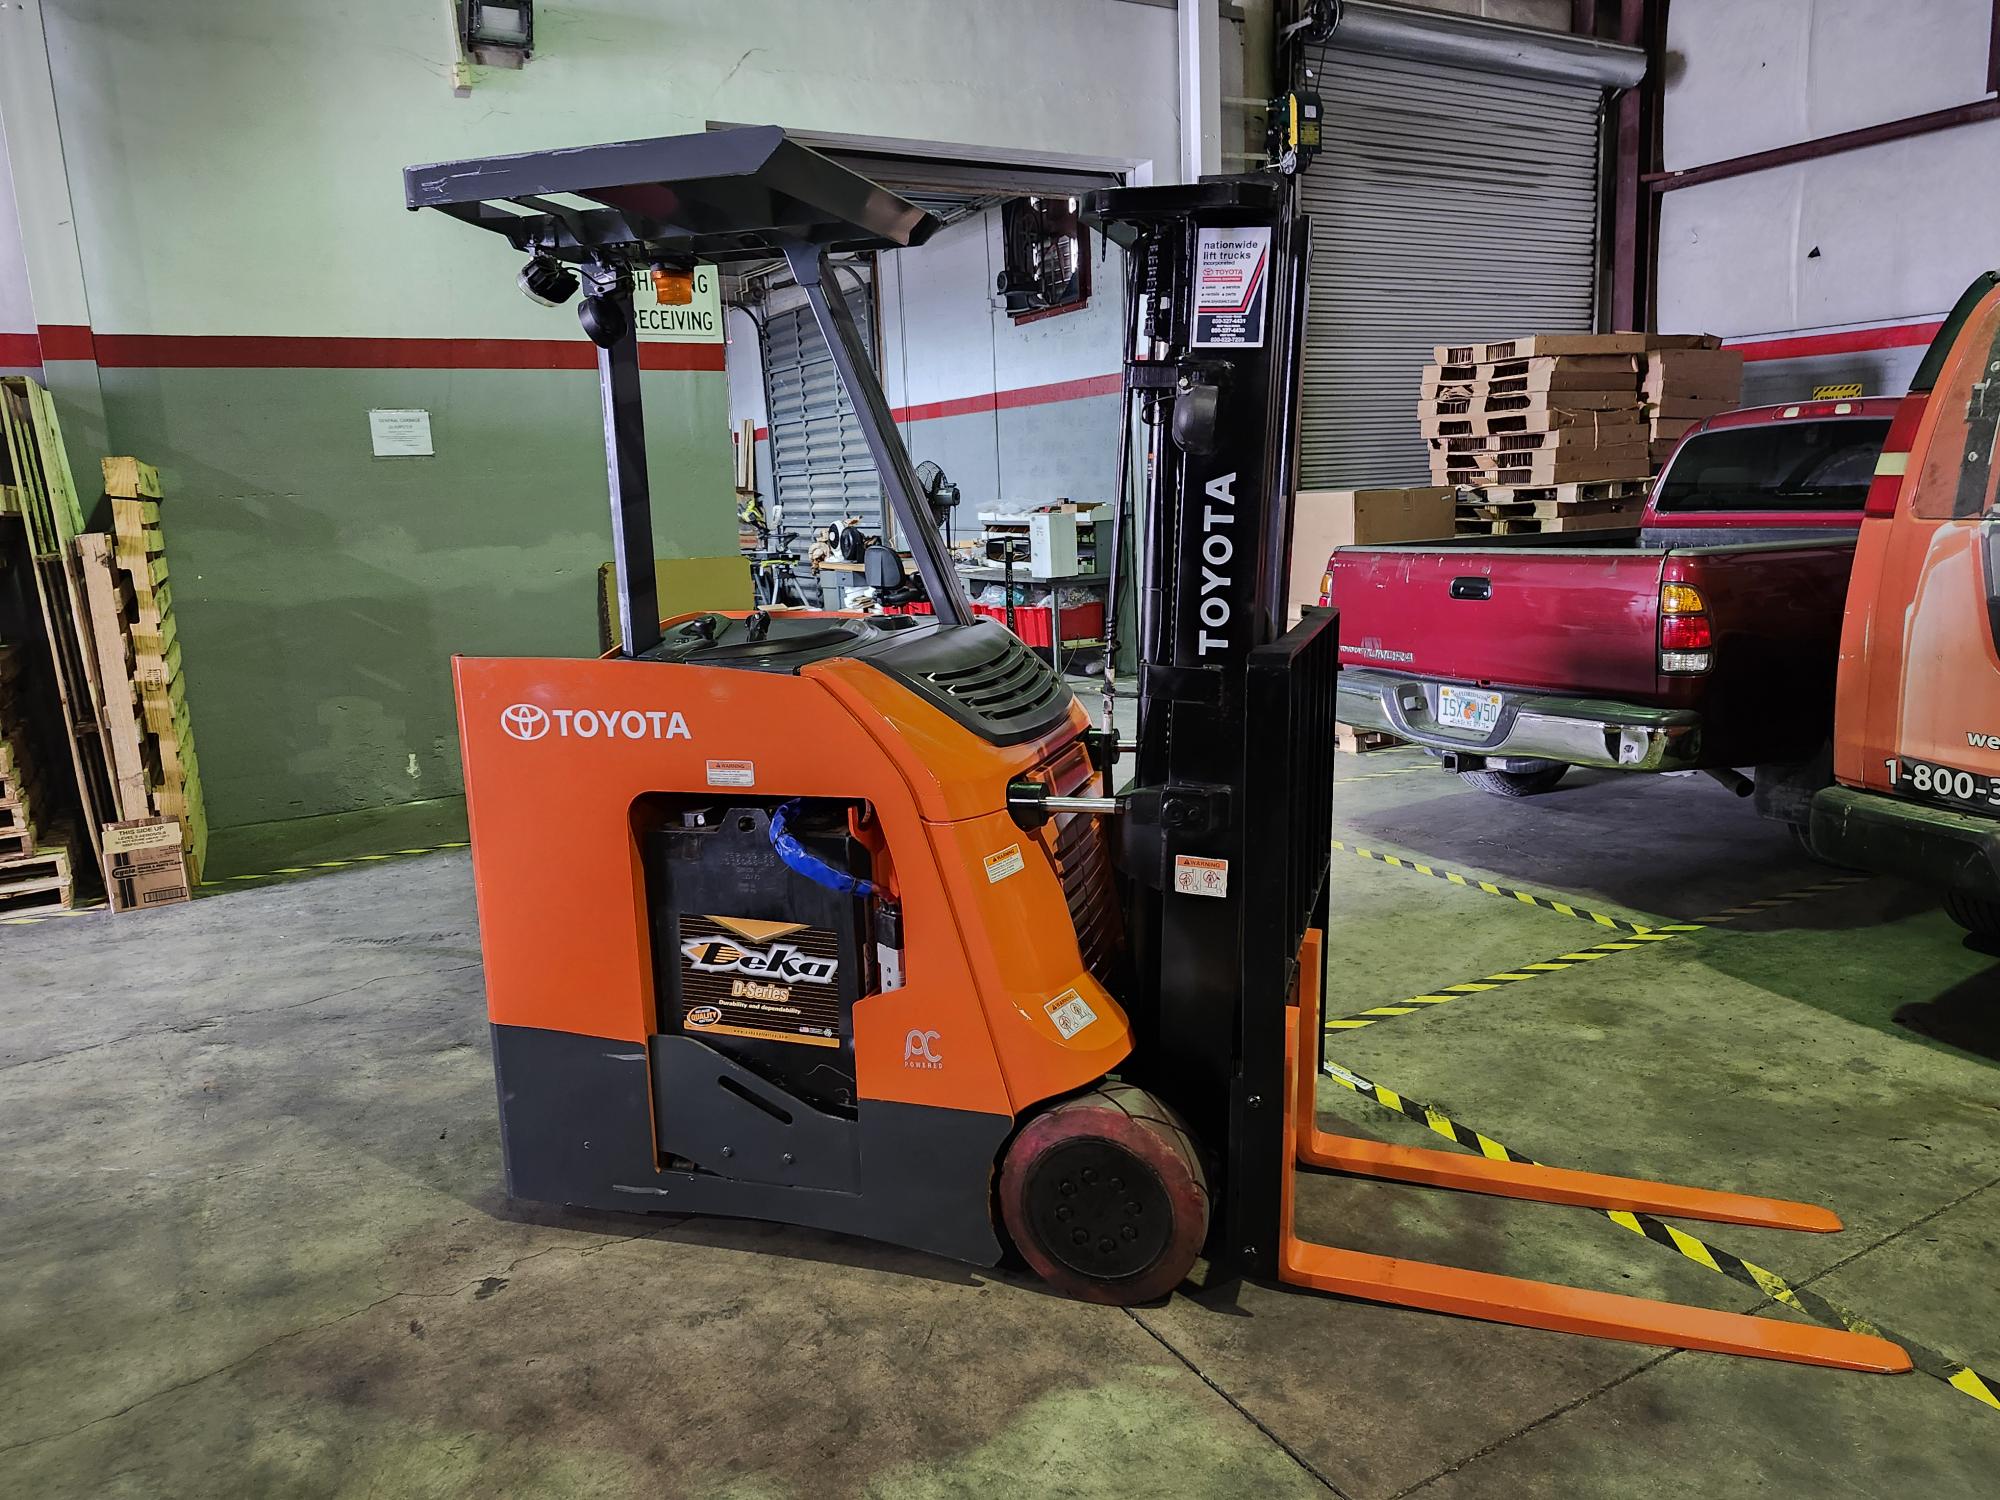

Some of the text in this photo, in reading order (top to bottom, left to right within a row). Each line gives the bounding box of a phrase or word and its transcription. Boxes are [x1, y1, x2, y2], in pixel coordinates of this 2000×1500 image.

[1204, 241, 1258, 250] nationwide
[1203, 251, 1252, 260] lift trucks
[1198, 472, 1237, 655] TOYOTA
[1442, 698, 1462, 718] ISX
[552, 709, 692, 740] TOYOTA
[1190, 860, 1220, 868] WARNING
[686, 940, 834, 979] Deka
[691, 1012, 717, 1020] QUALITY
[718, 1000, 747, 1008] Durability
[761, 1005, 801, 1015] dependability
[905, 1029, 942, 1063] AC
